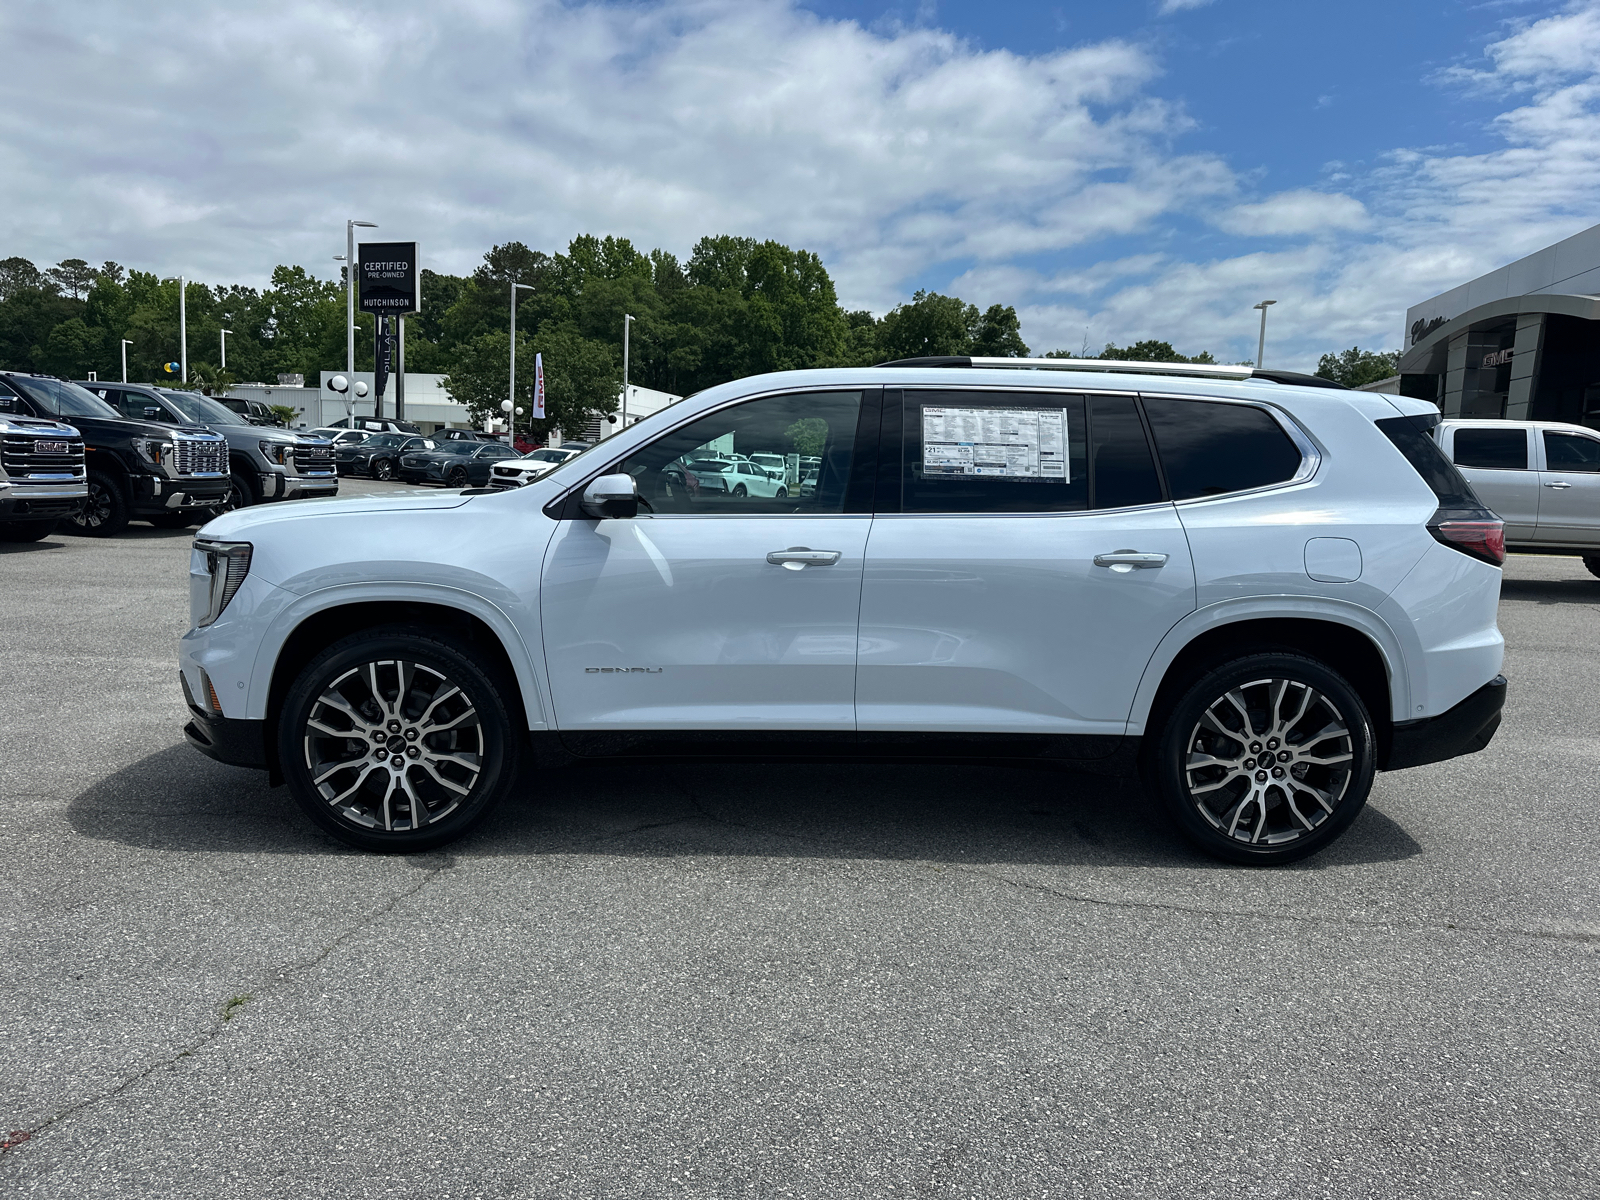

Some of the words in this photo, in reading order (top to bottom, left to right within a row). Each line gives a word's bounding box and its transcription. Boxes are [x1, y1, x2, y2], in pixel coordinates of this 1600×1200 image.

[364, 261, 408, 270] CERTIFIED
[363, 298, 409, 306] HUTCHINSON
[1483, 348, 1514, 367] GMC
[38, 442, 67, 452] GMC
